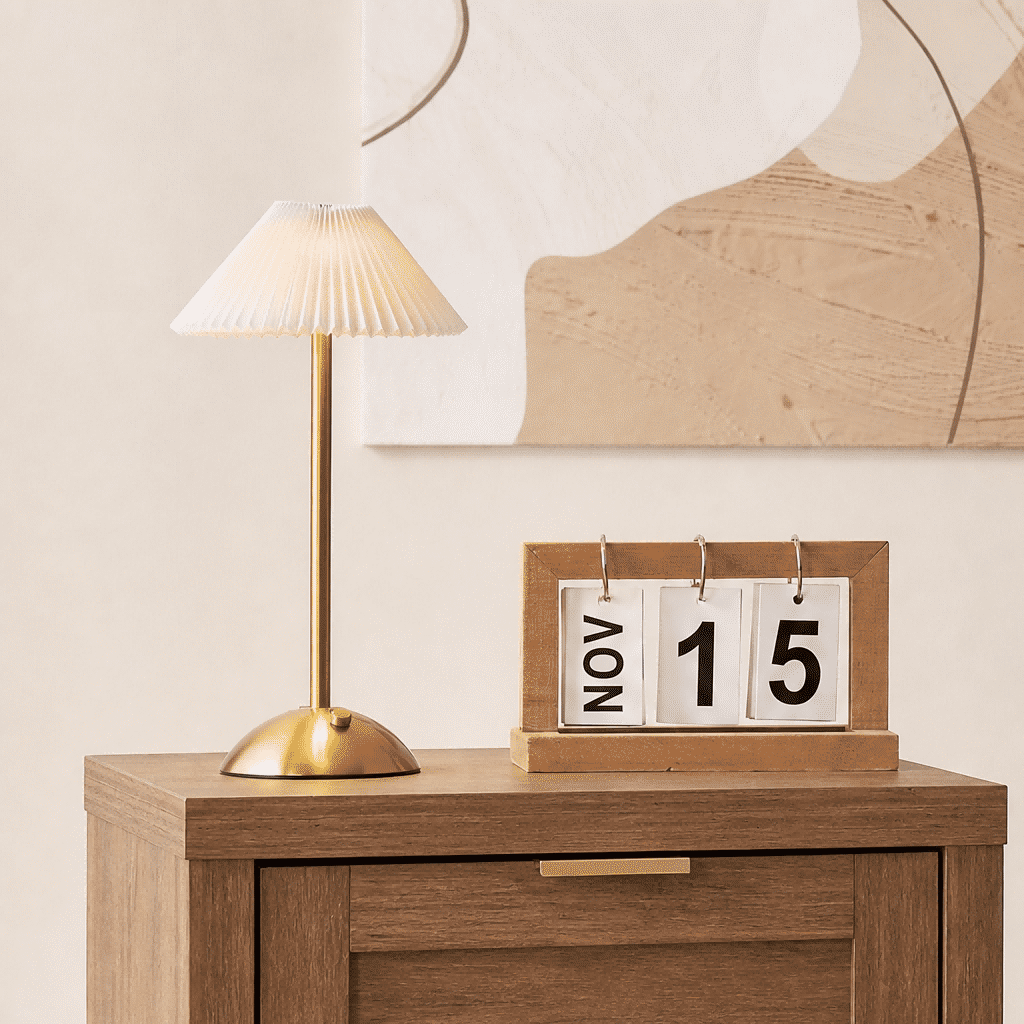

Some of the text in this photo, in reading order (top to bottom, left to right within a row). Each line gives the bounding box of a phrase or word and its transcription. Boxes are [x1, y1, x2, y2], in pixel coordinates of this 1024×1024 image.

[582, 614, 821, 713] NOV 1 5
